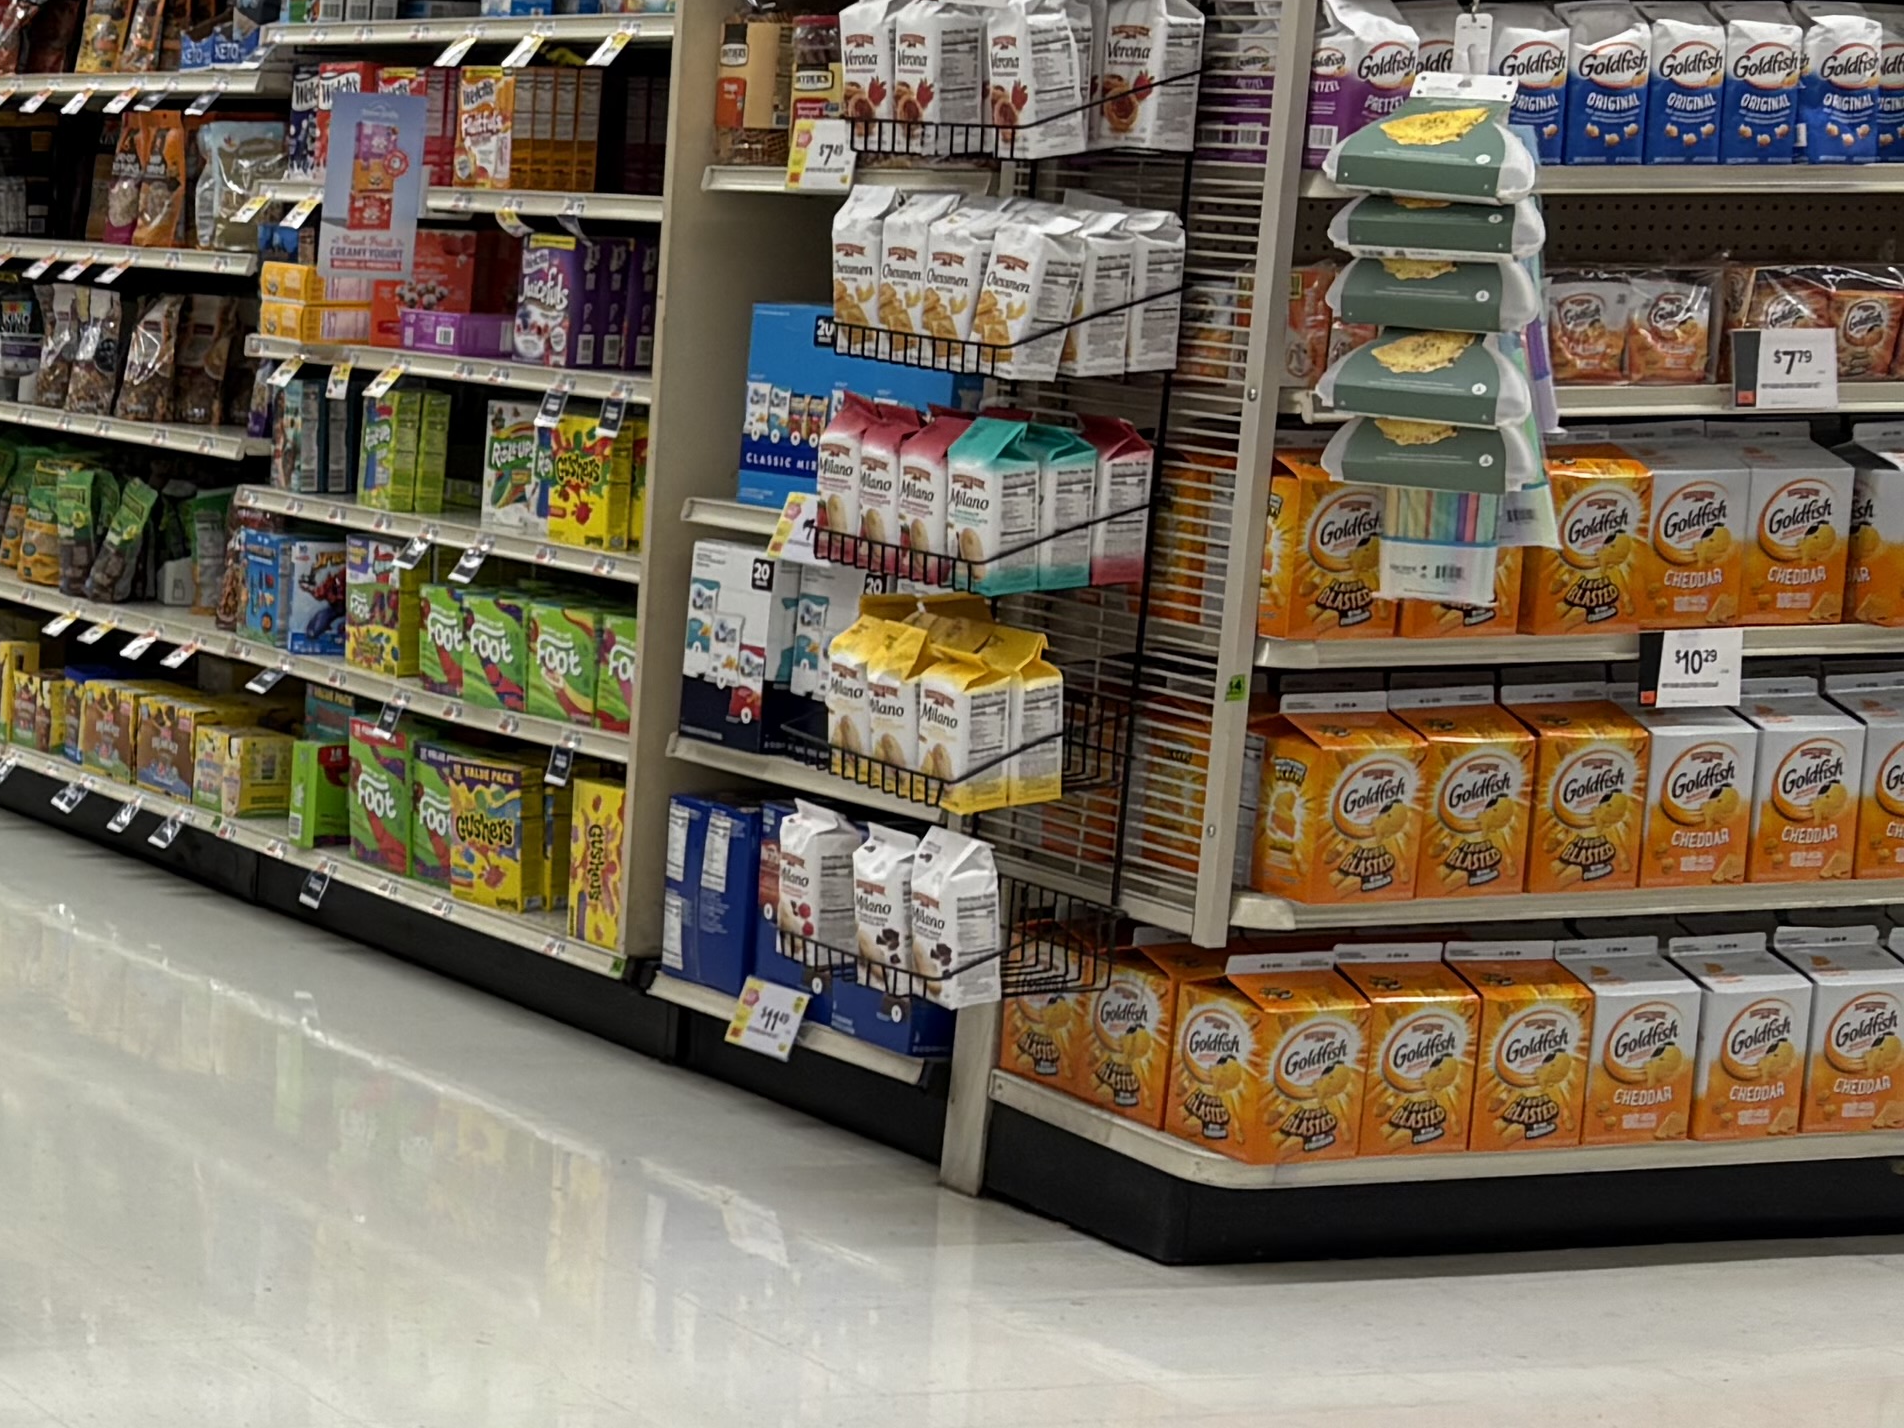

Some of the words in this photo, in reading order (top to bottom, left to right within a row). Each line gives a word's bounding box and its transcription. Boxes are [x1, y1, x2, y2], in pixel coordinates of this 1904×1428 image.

[1107, 41, 1151, 61] Verona
[1667, 93, 1716, 110] ORIGINAL
[1740, 93, 1791, 110] ORIGINAL
[926, 268, 969, 288] Chessmen
[746, 452, 792, 468] CLASSIC
[949, 488, 989, 510] Milano
[1664, 500, 1727, 539] Goldfish
[754, 562, 770, 580] 20
[1664, 568, 1722, 588] CHEDDAR
[1614, 1087, 1672, 1106] CHEDDAR
